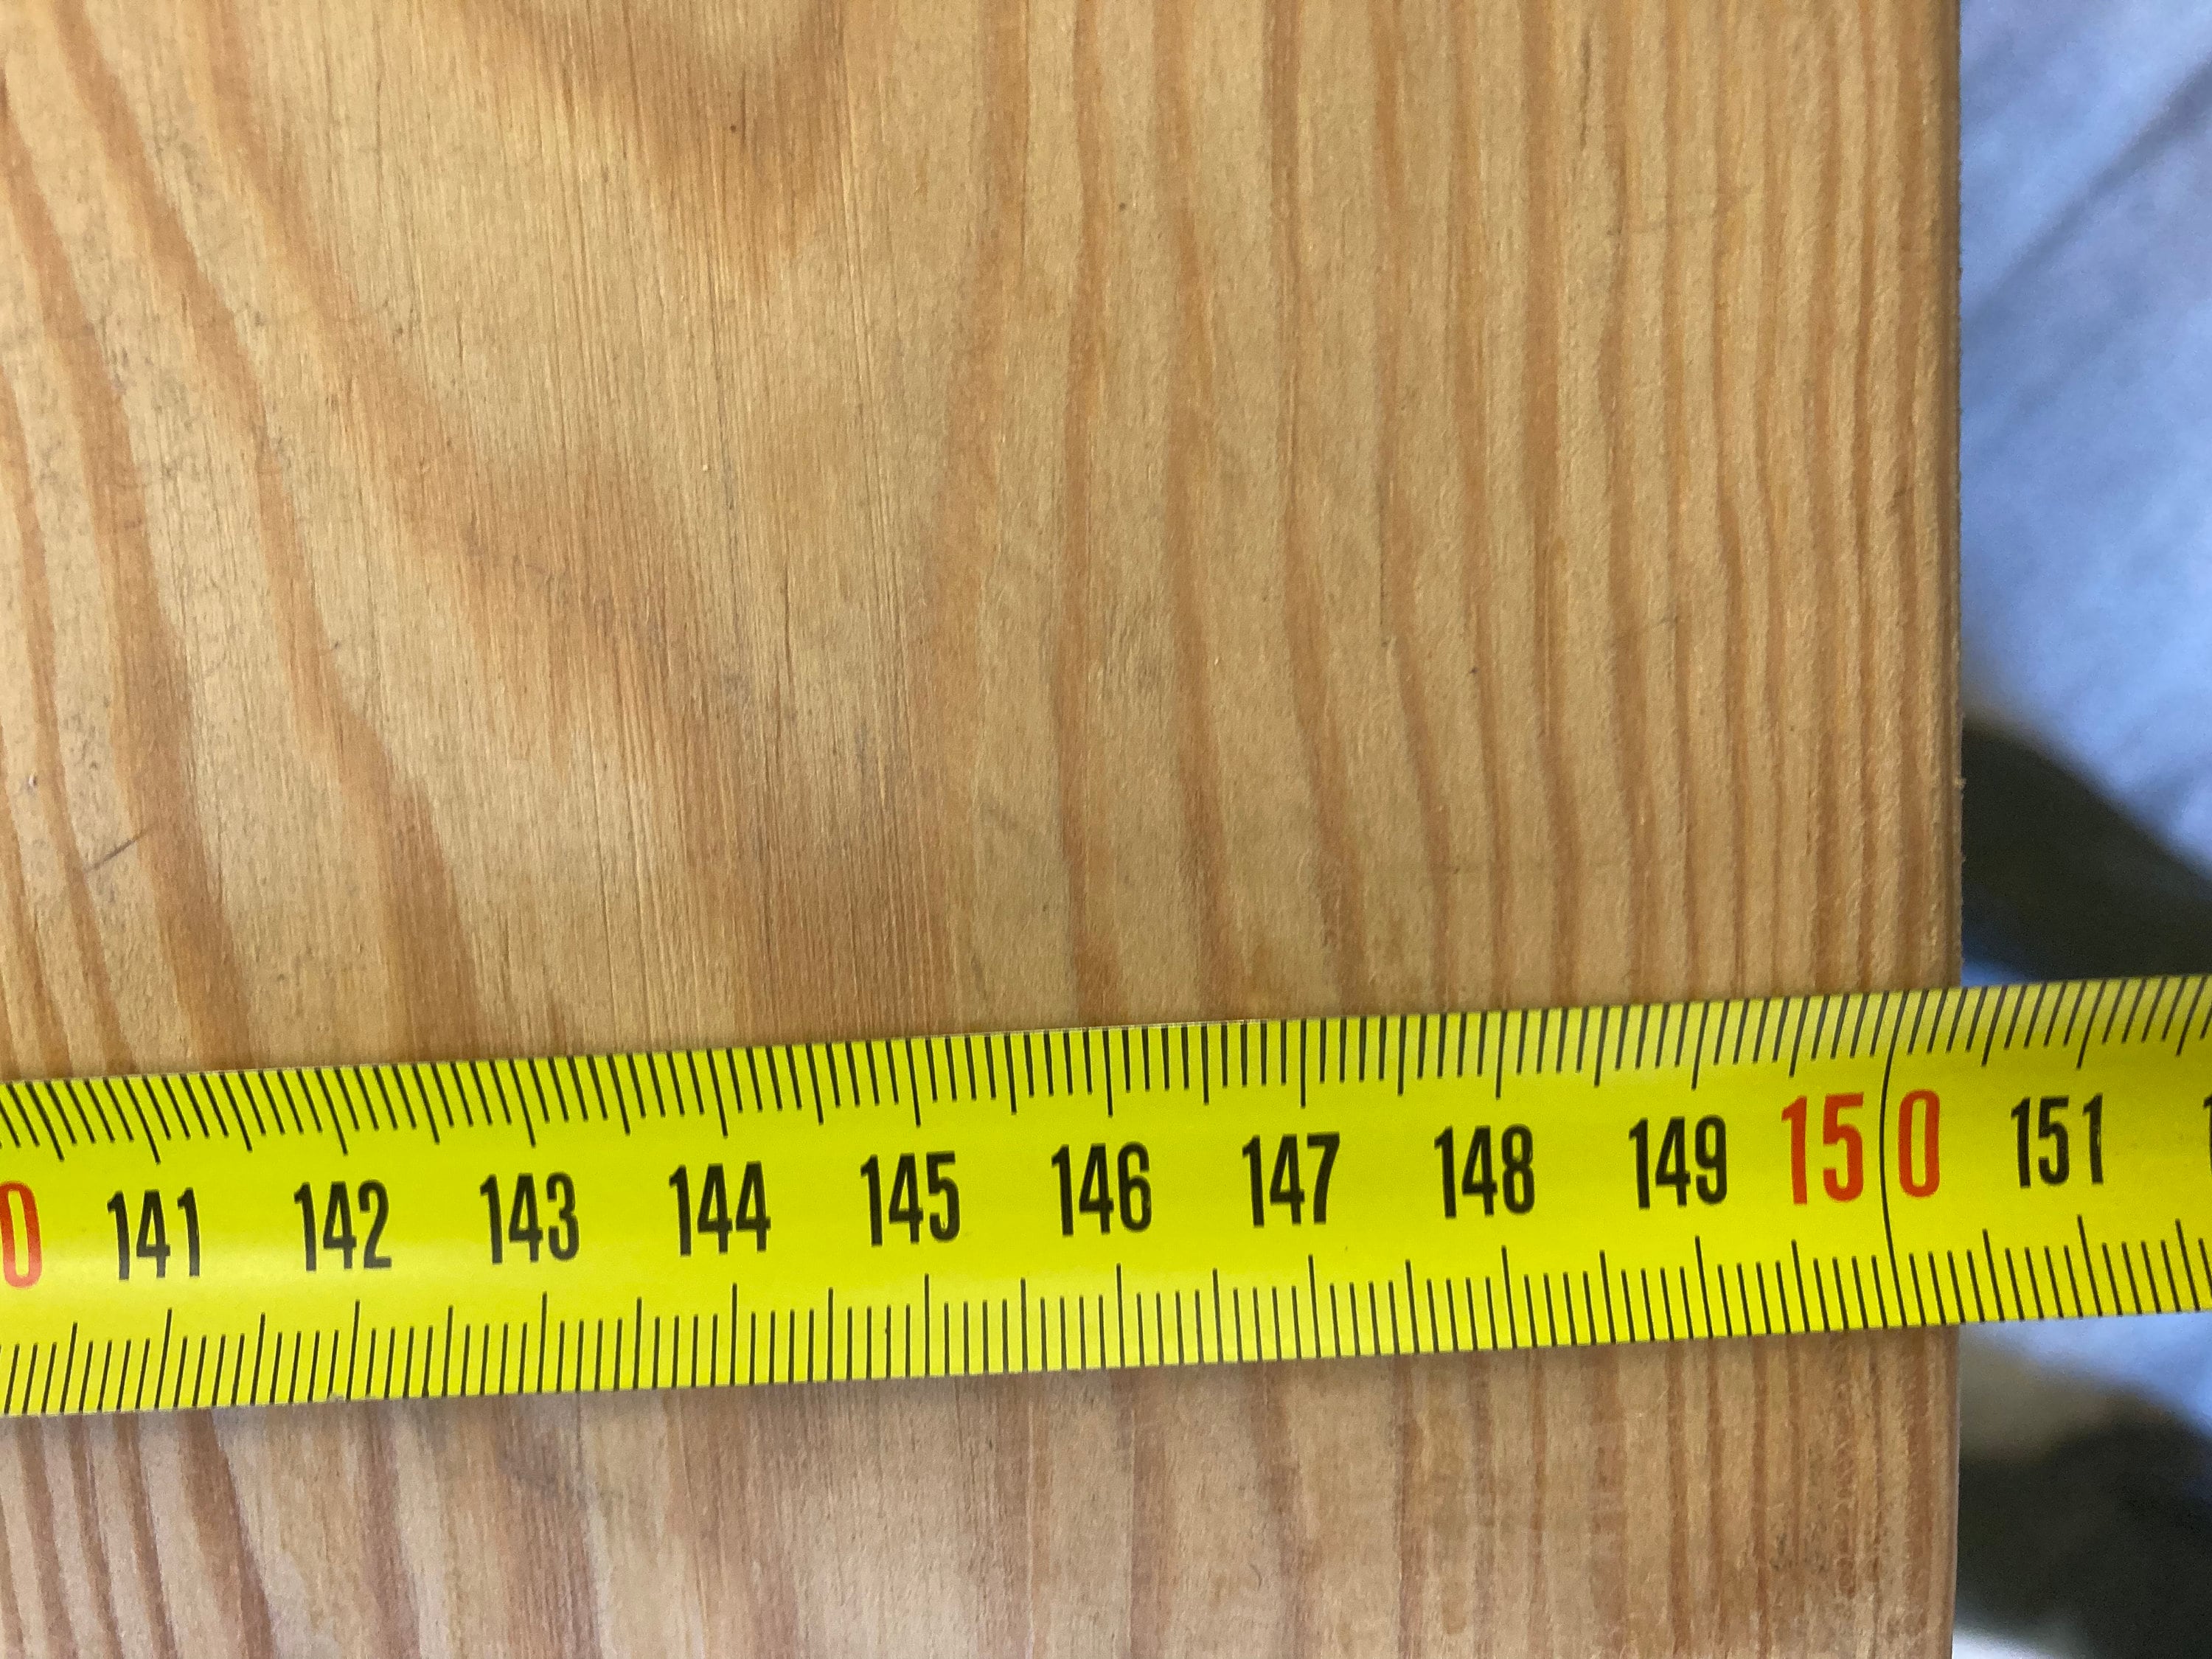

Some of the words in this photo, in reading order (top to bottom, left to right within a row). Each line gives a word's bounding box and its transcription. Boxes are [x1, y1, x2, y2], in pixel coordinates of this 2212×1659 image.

[107, 1187, 201, 1280] 141
[293, 1180, 392, 1271] 142
[479, 1172, 580, 1264] 143
[669, 1162, 771, 1256] 144
[860, 1152, 960, 1246] 145
[1051, 1142, 1152, 1236] 146
[1242, 1132, 1340, 1227] 147
[1434, 1124, 1535, 1218] 148
[1629, 1115, 1728, 1209] 149
[1781, 1088, 1941, 1205] 150
[2010, 1092, 2104, 1189] 151
